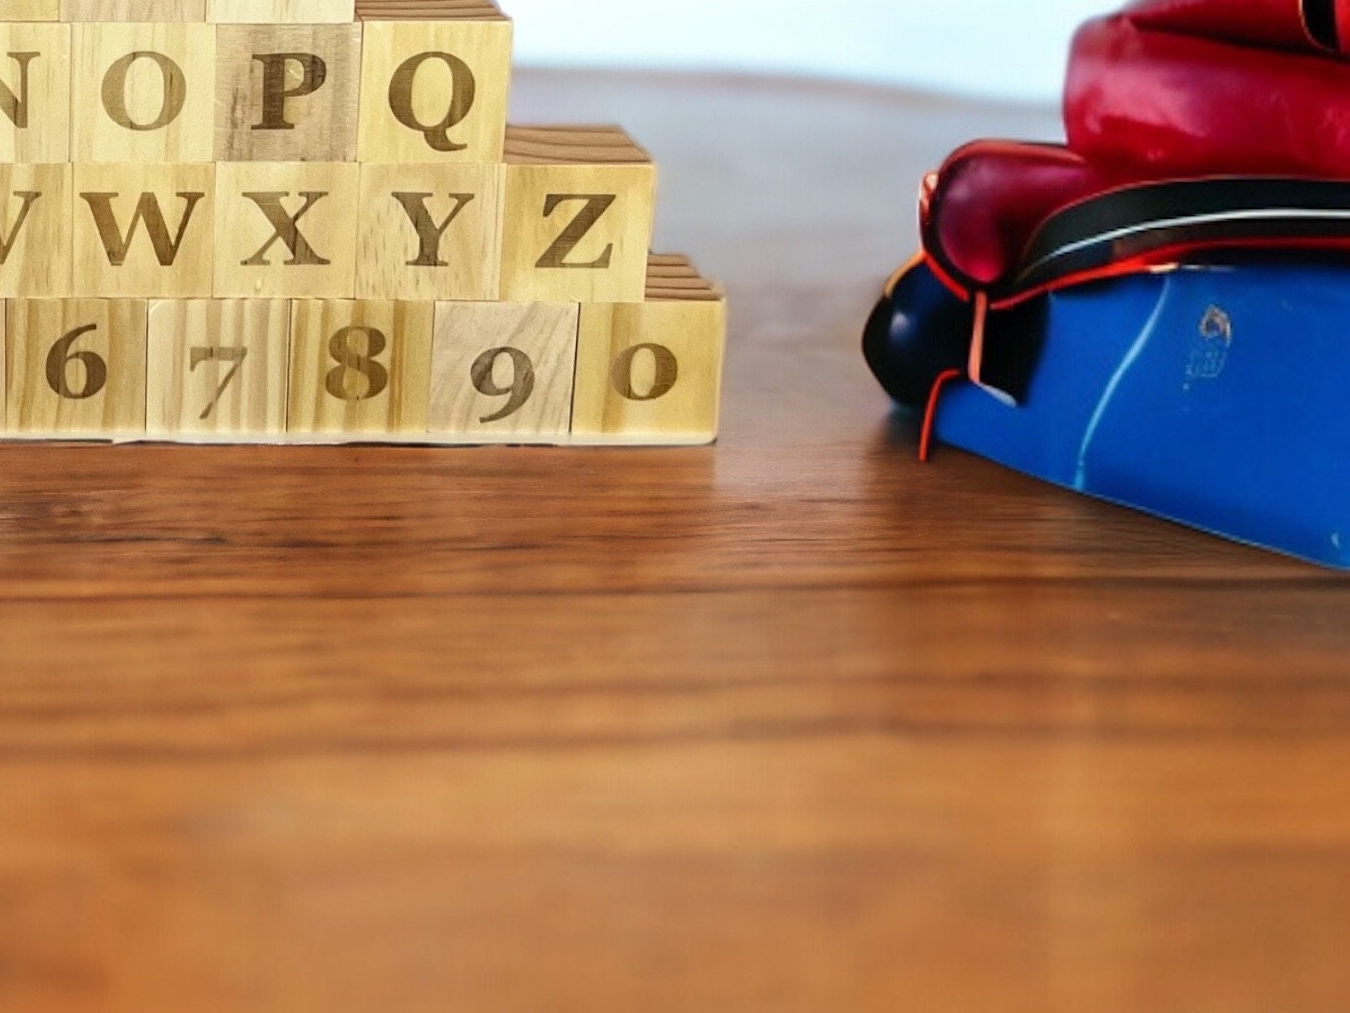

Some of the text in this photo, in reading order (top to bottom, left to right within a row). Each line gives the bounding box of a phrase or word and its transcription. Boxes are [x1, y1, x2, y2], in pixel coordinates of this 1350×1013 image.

[101, 51, 187, 132] O
[251, 52, 327, 130] P
[388, 51, 475, 152] Q
[79, 190, 205, 266] W
[240, 190, 331, 266] X
[391, 191, 475, 267] Y
[535, 193, 616, 269] Z
[45, 322, 107, 400] 6
[188, 346, 248, 420] 7
[325, 325, 389, 401] 8
[469, 347, 536, 424] 9
